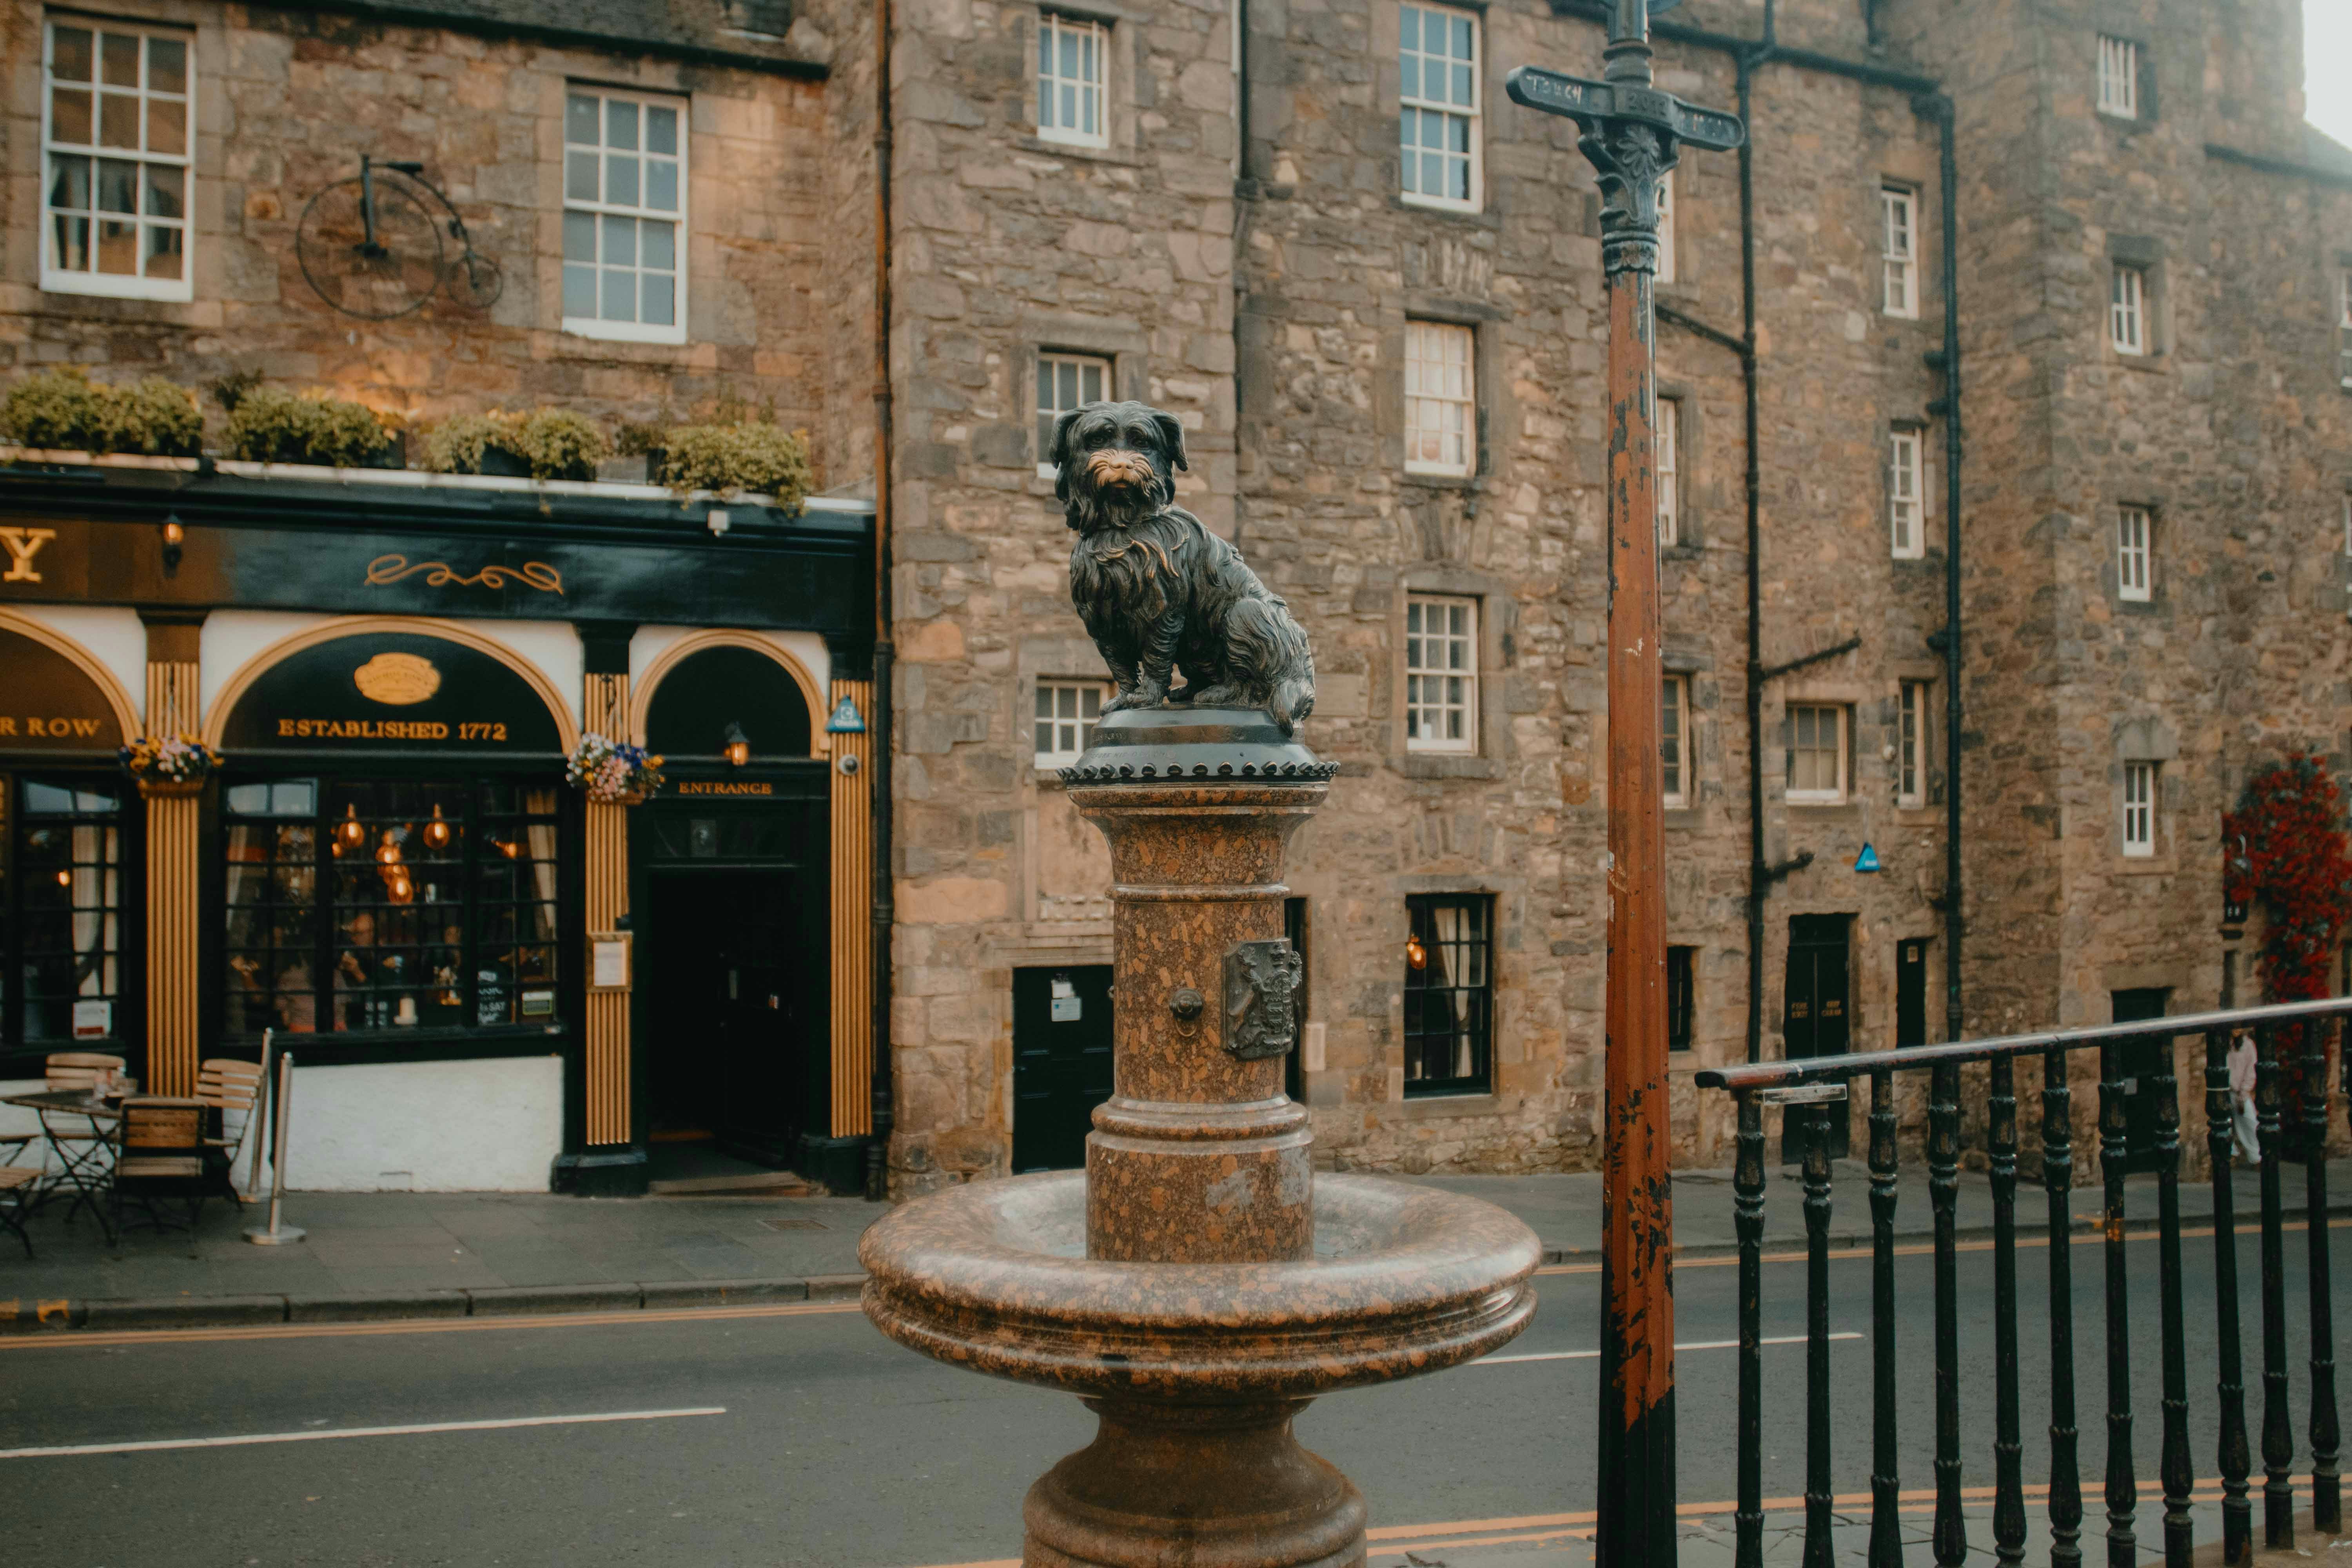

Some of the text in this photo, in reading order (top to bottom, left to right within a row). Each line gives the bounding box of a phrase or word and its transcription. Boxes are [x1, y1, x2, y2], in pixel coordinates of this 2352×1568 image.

[26, 717, 101, 738] ROW
[277, 719, 507, 741] ESTABLISHED 1772
[679, 782, 772, 795] ENTRANCE
